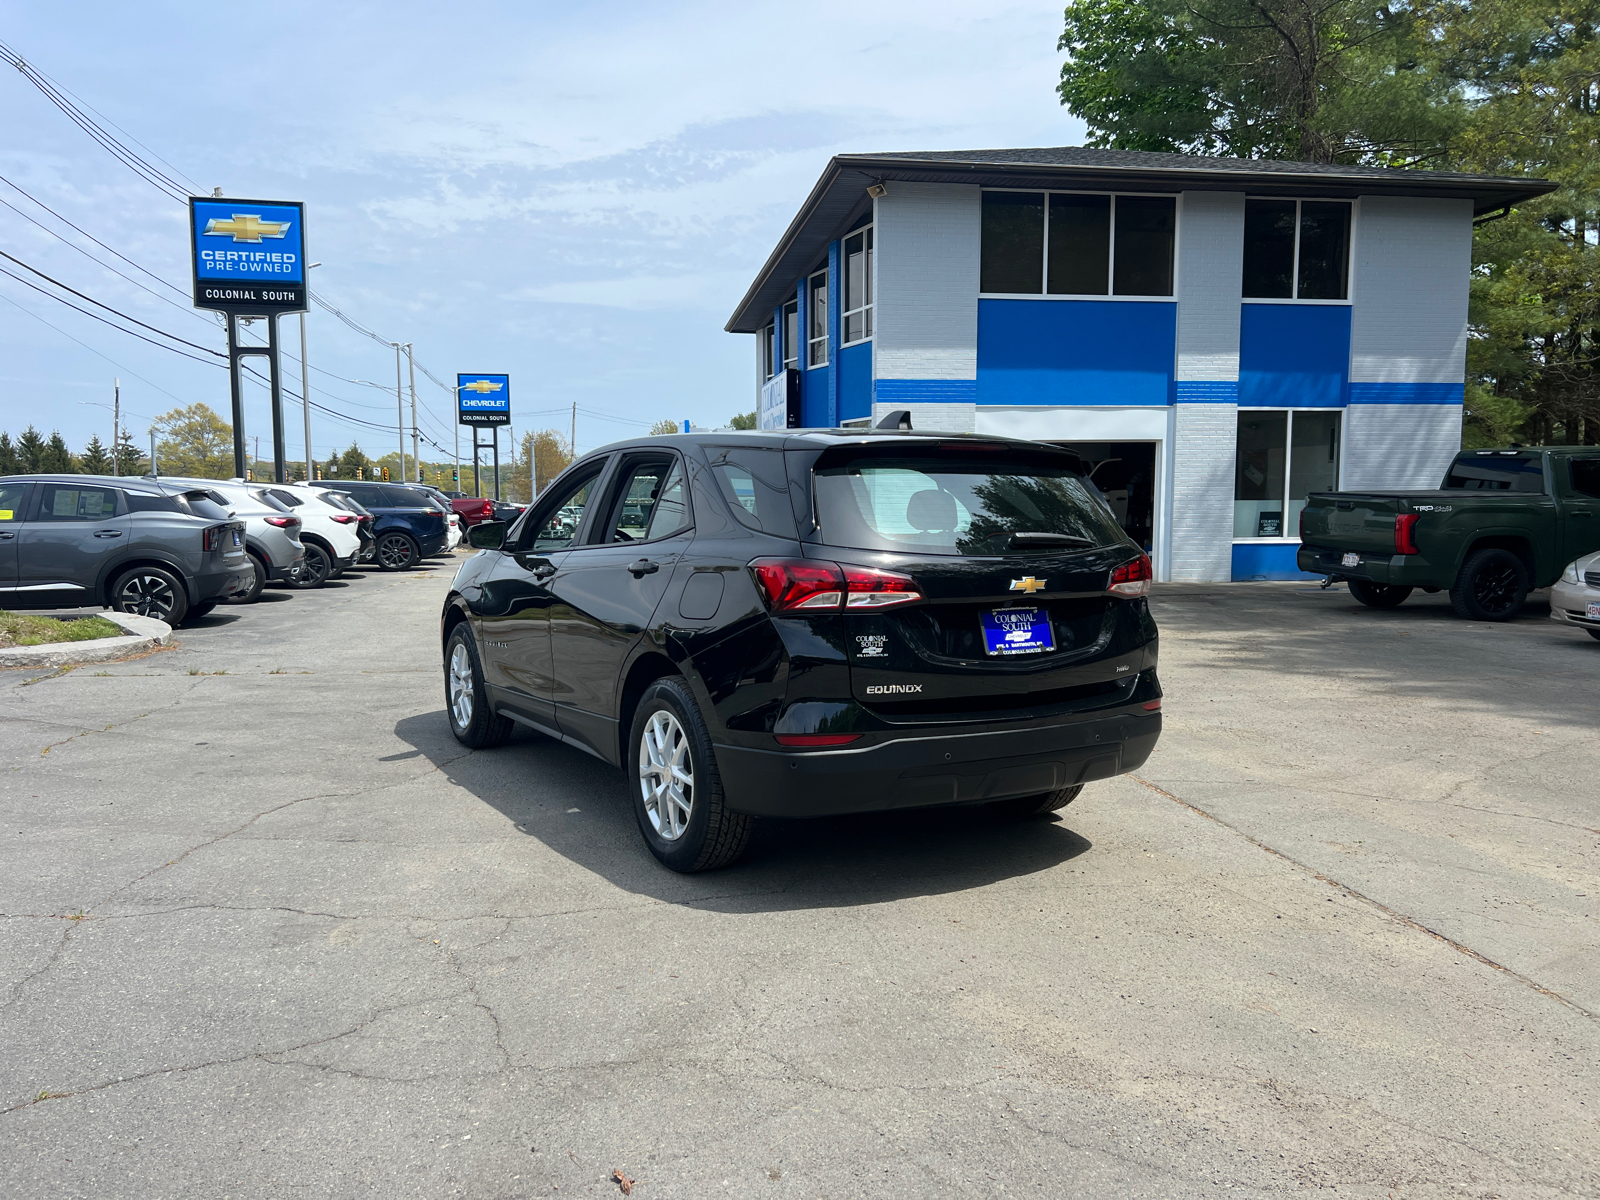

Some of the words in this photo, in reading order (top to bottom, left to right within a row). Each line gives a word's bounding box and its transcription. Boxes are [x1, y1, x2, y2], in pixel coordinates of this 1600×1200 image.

[201, 250, 296, 263] CERTIFIED
[206, 261, 292, 273] PRE-OWNED
[205, 289, 257, 300] COLONIAL
[262, 291, 295, 301] SOUTH
[994, 613, 1036, 624] COLONIAL
[1002, 622, 1031, 632] SOUTH
[866, 684, 923, 695] EQUINOX
